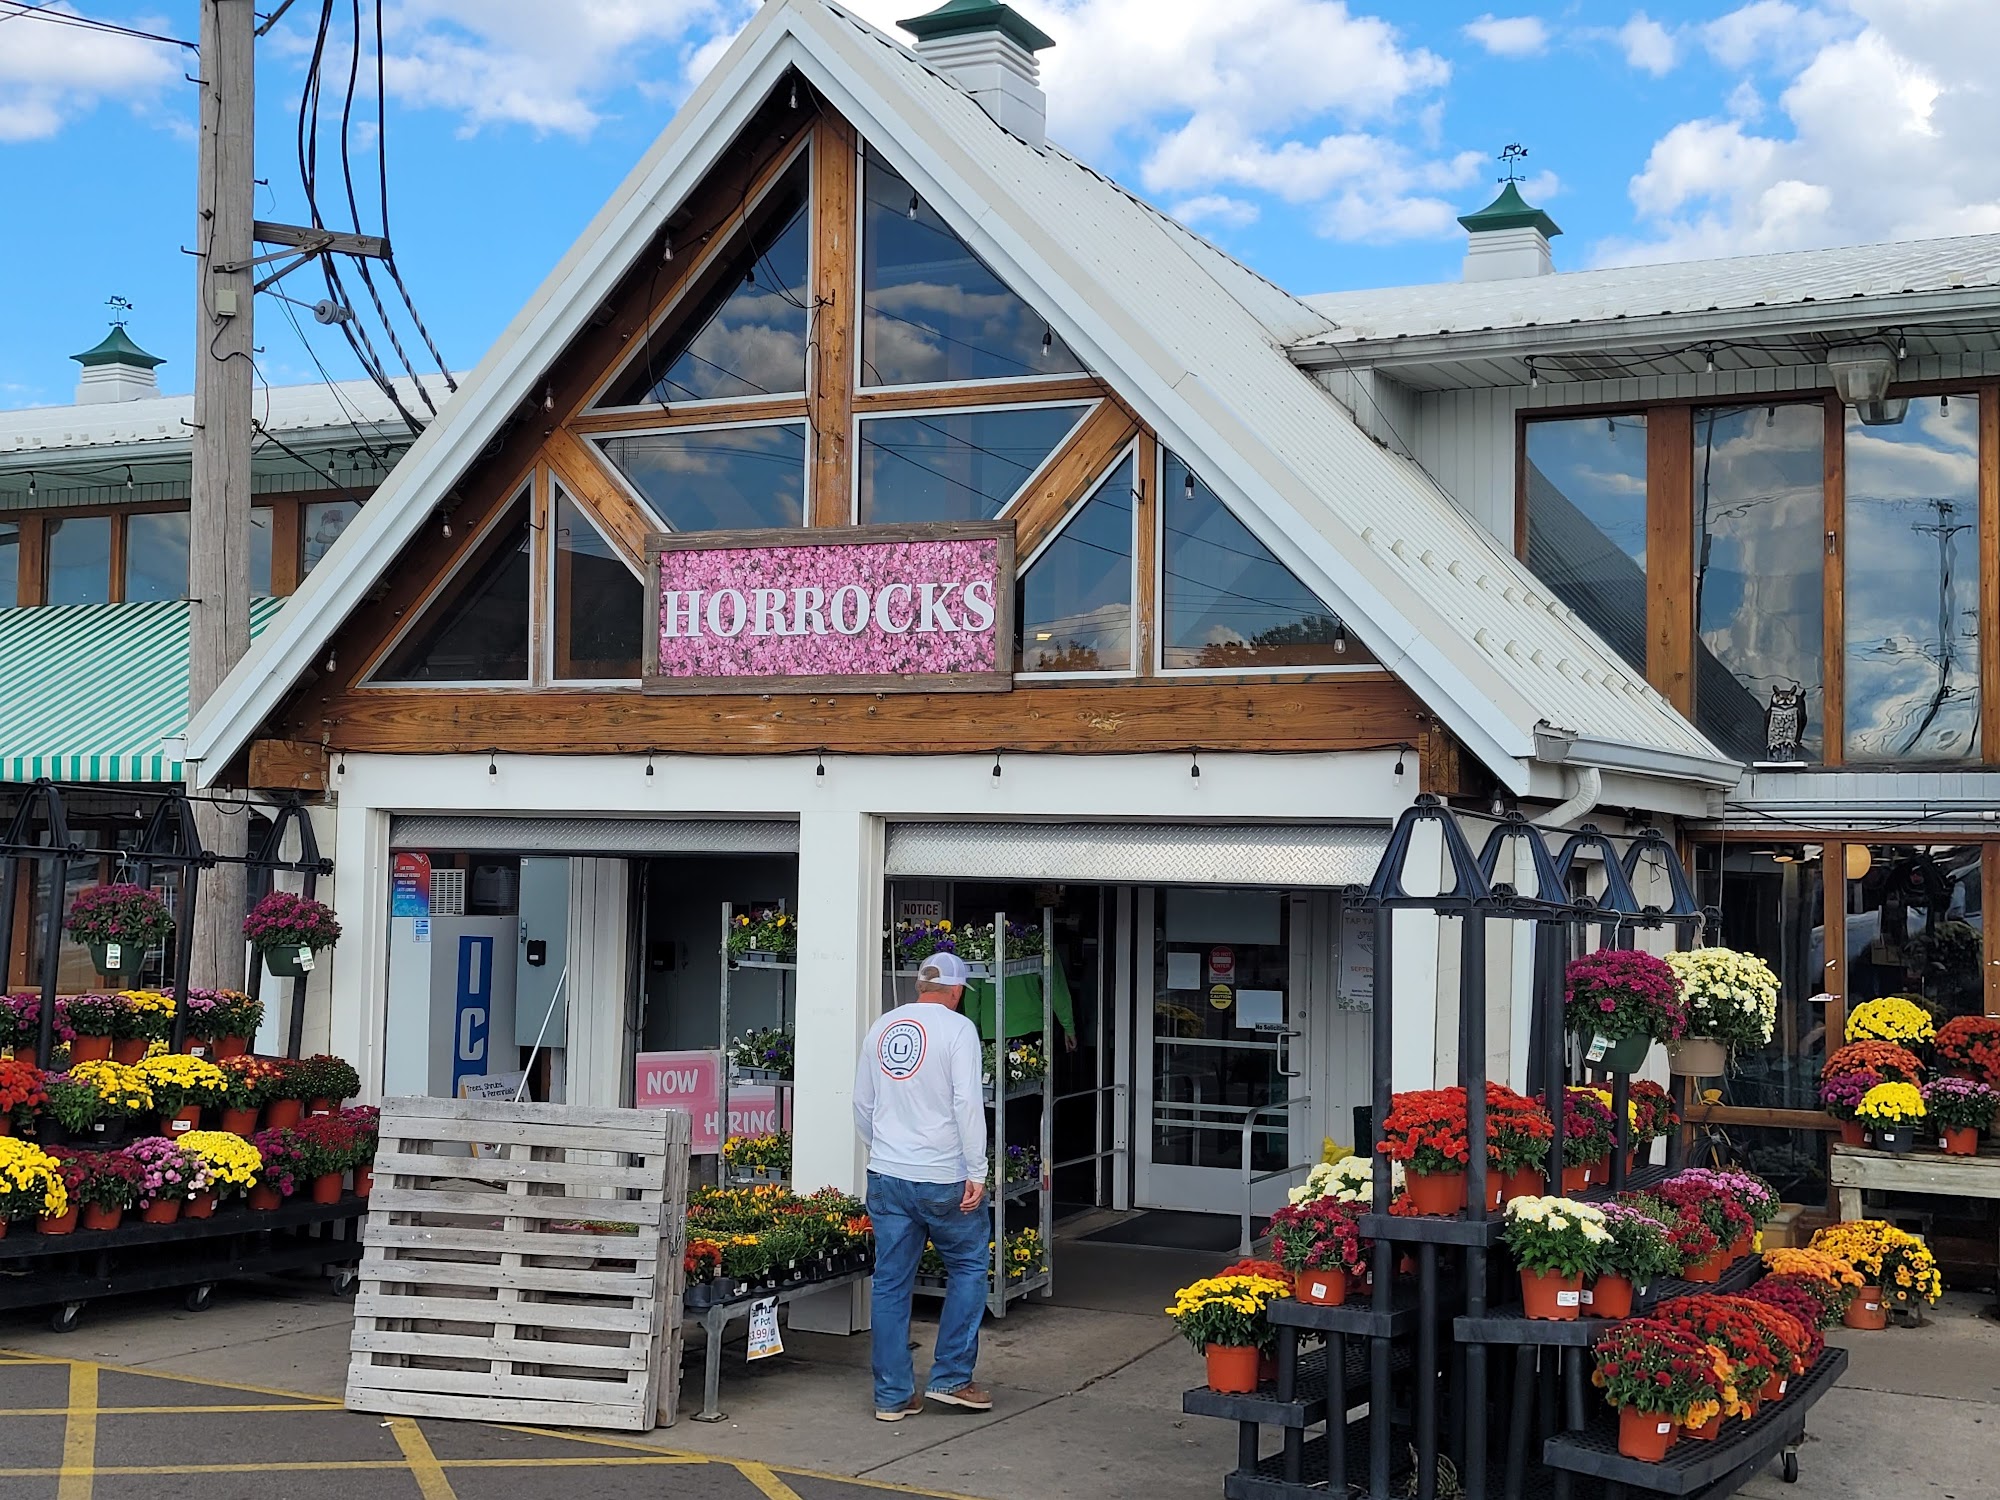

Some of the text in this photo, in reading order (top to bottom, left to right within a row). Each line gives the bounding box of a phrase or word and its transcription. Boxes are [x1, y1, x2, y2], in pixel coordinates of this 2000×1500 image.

[661, 580, 995, 638] HORROCKS
[903, 903, 939, 916] NOTICE
[458, 941, 487, 1098] IC
[646, 1068, 699, 1095] NOW
[704, 1108, 776, 1135] HRING
